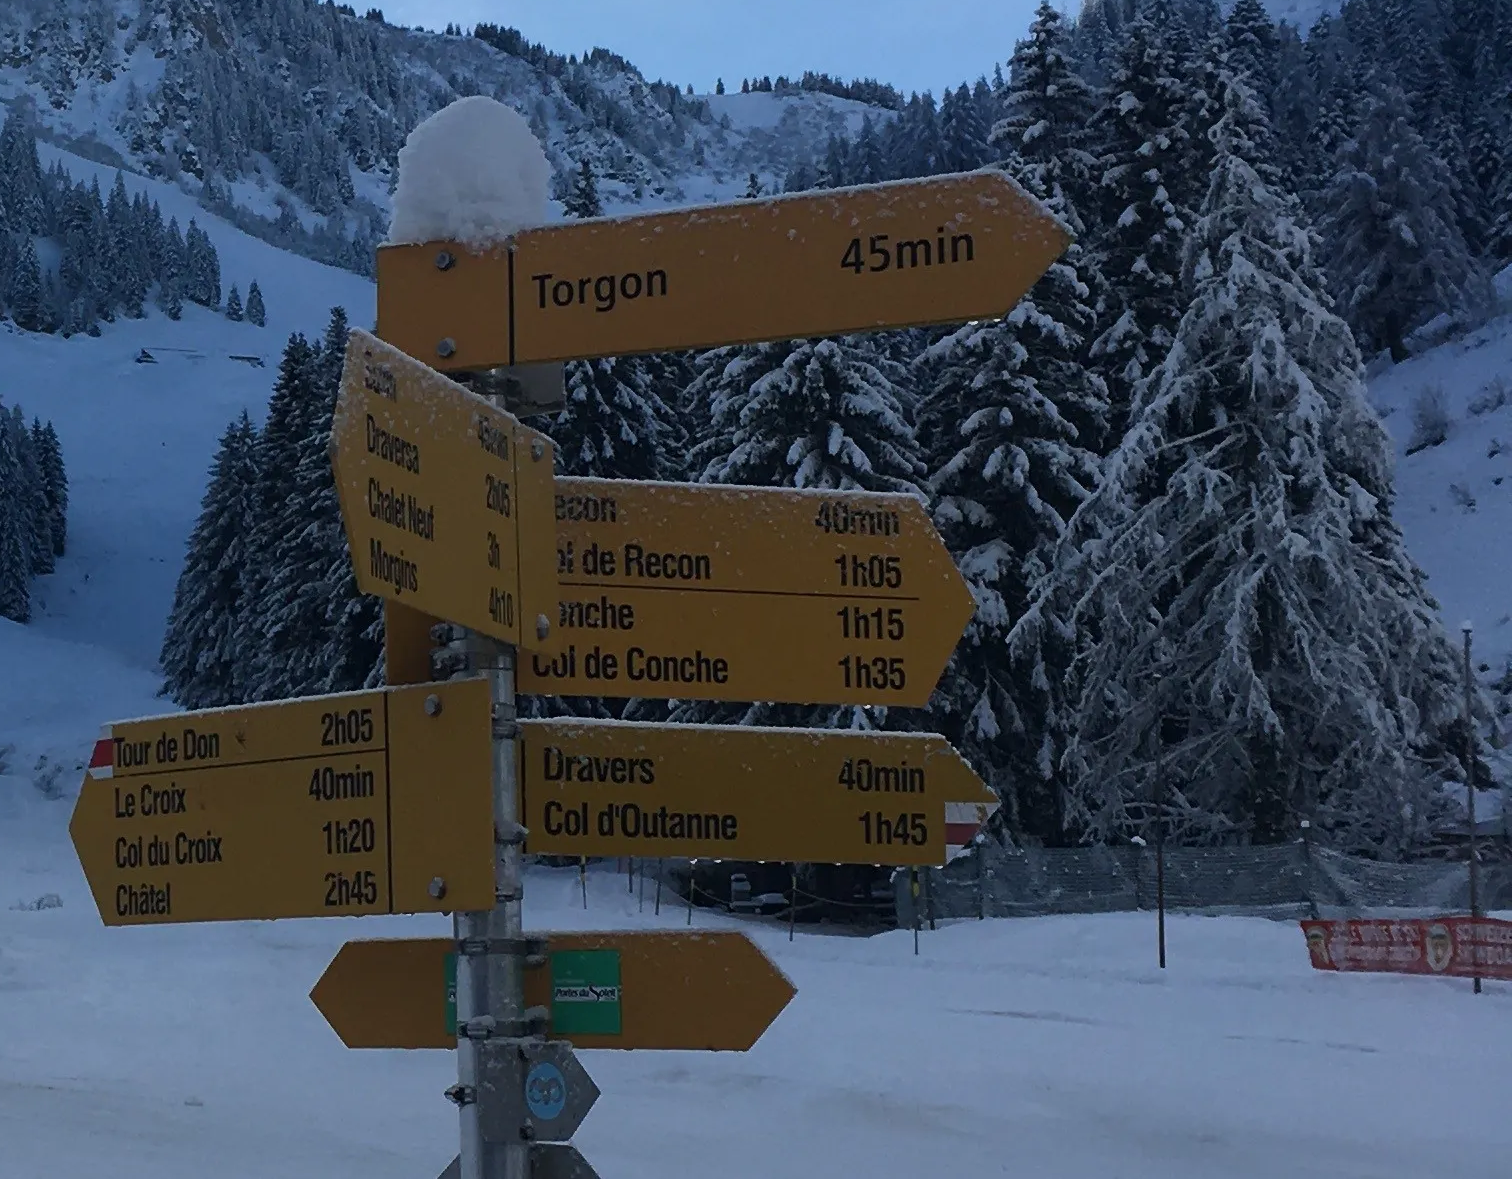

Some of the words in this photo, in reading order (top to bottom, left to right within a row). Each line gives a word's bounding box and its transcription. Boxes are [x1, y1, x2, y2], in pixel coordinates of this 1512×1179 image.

[531, 265, 668, 312] Torgon
[841, 227, 975, 274] 45min
[367, 413, 419, 474] Draversa
[485, 474, 511, 518] 2h05
[368, 477, 406, 530] Chalet
[488, 531, 501, 569] 3h
[555, 494, 617, 522] econ
[815, 501, 900, 536] 40min
[370, 538, 418, 595] Morgins
[489, 587, 513, 628] 4h10
[582, 542, 616, 576] de
[624, 543, 711, 580] Recon
[835, 554, 902, 589] 1h05
[559, 595, 634, 630] nche
[837, 606, 904, 641] 1h15
[584, 646, 618, 680] de
[626, 647, 729, 684] Conche
[838, 655, 906, 691] 1h35
[114, 736, 151, 768] Tour
[156, 732, 178, 763] de
[183, 729, 220, 761] Don
[321, 708, 374, 747] 2h05
[115, 788, 136, 818] Le
[140, 781, 187, 816] Croix
[309, 764, 374, 801] 40min
[543, 746, 655, 785] Dravers
[839, 758, 925, 794] 40min
[115, 835, 144, 869] Col
[148, 835, 170, 866] du
[176, 831, 223, 864] Croix
[322, 819, 375, 855] 1h20
[543, 800, 588, 837] Col
[598, 802, 738, 841] d'Outanne
[859, 811, 928, 846] 1h45
[116, 882, 171, 917] Châtel
[324, 870, 378, 907] 2h45
[556, 987, 579, 998] Portes
[579, 987, 590, 997] du
[588, 984, 616, 1002] Soleil
